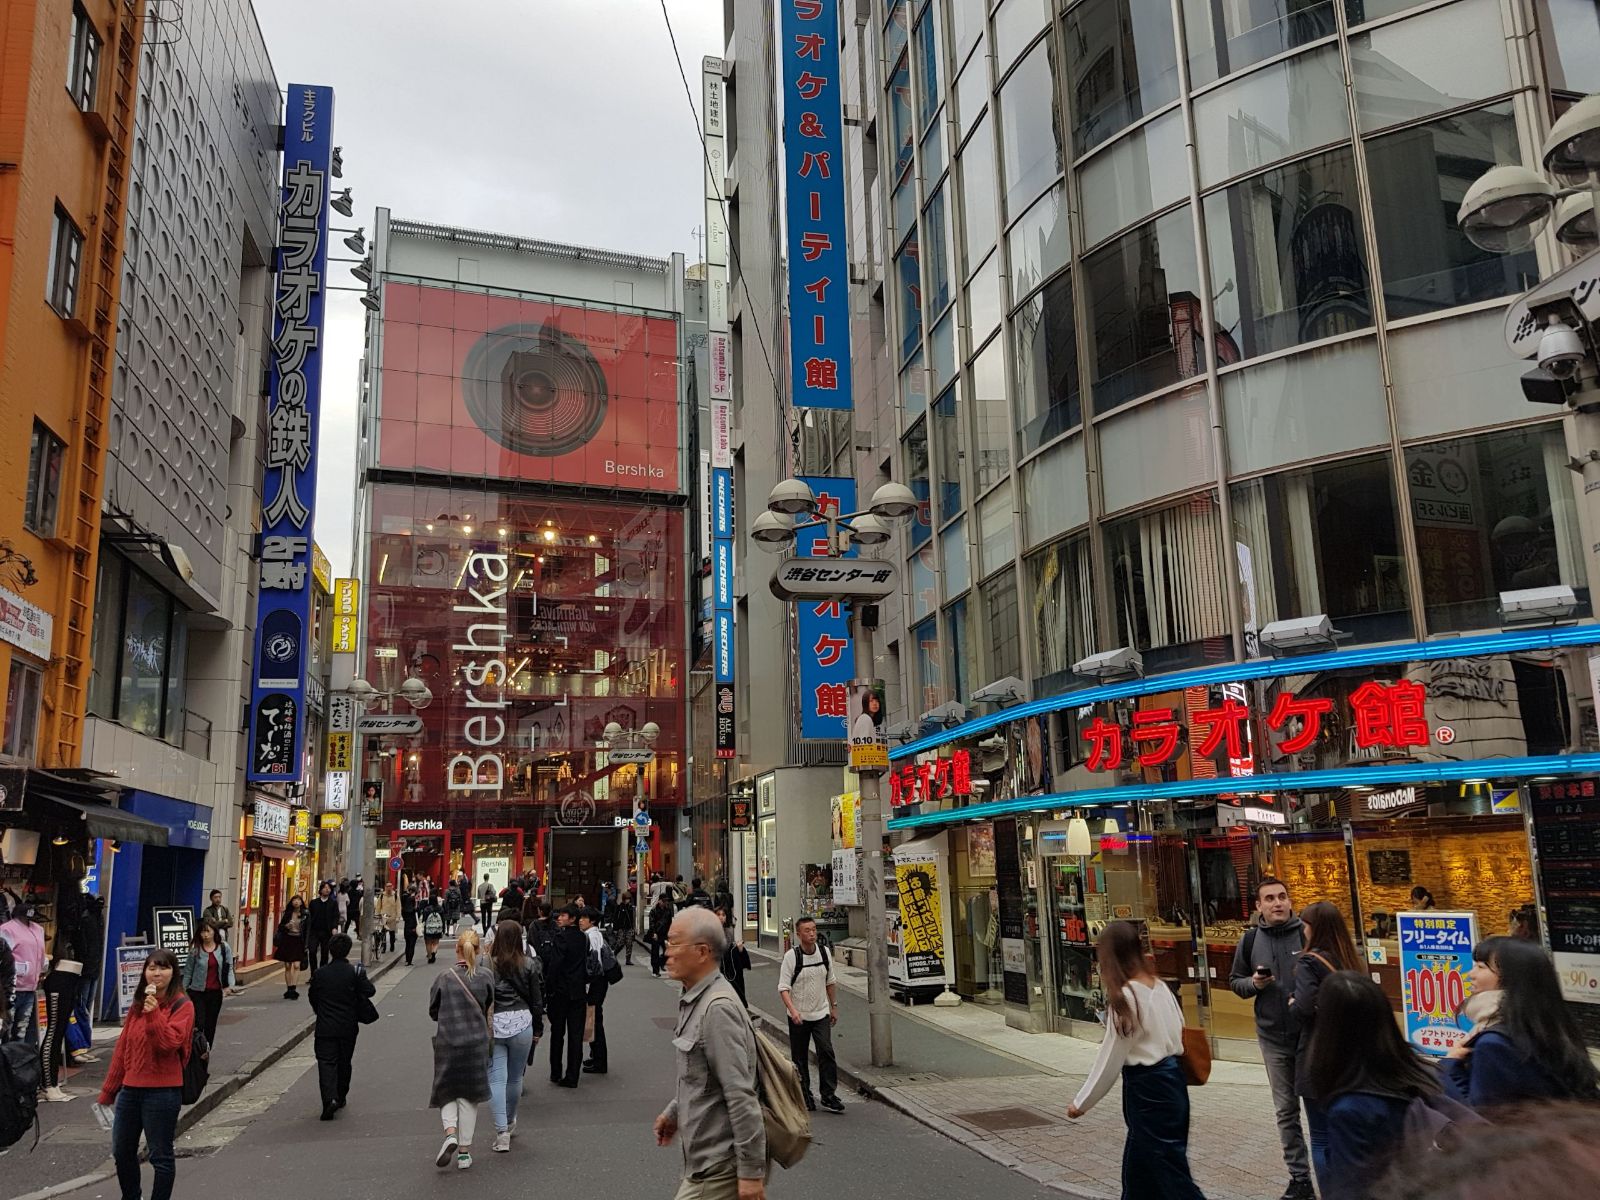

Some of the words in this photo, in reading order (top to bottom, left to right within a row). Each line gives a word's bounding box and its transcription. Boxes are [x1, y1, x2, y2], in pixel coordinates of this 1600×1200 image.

[709, 81, 719, 127] 林土地建物
[302, 89, 317, 142] キラクビル
[262, 160, 325, 529] カラオケの鉄人
[714, 385, 725, 393] 5F
[605, 460, 664, 478] Bershka
[718, 474, 726, 532] SKECHERS
[263, 536, 308, 561] 2F
[261, 562, 308, 590] 受付
[719, 545, 728, 604] SKECHERS
[784, 566, 893, 584] 渋谷センター街
[720, 616, 729, 677] SKECHERS
[448, 552, 508, 790] Bershka
[359, 720, 418, 728] 渋谷センター街
[1083, 680, 1430, 772] カラオケ館
[852, 736, 873, 745] 10.10
[272, 763, 287, 773] B1
[889, 749, 970, 806] カラオケ館
[400, 819, 443, 831] Bershka
[614, 816, 652, 827] Bersa
[481, 860, 507, 868] Bershka
[1414, 919, 1457, 929] 特別限定
[163, 932, 188, 941] FREE
[1402, 930, 1470, 945] フリータイム
[1421, 1029, 1466, 1039] ソフトドリンク
